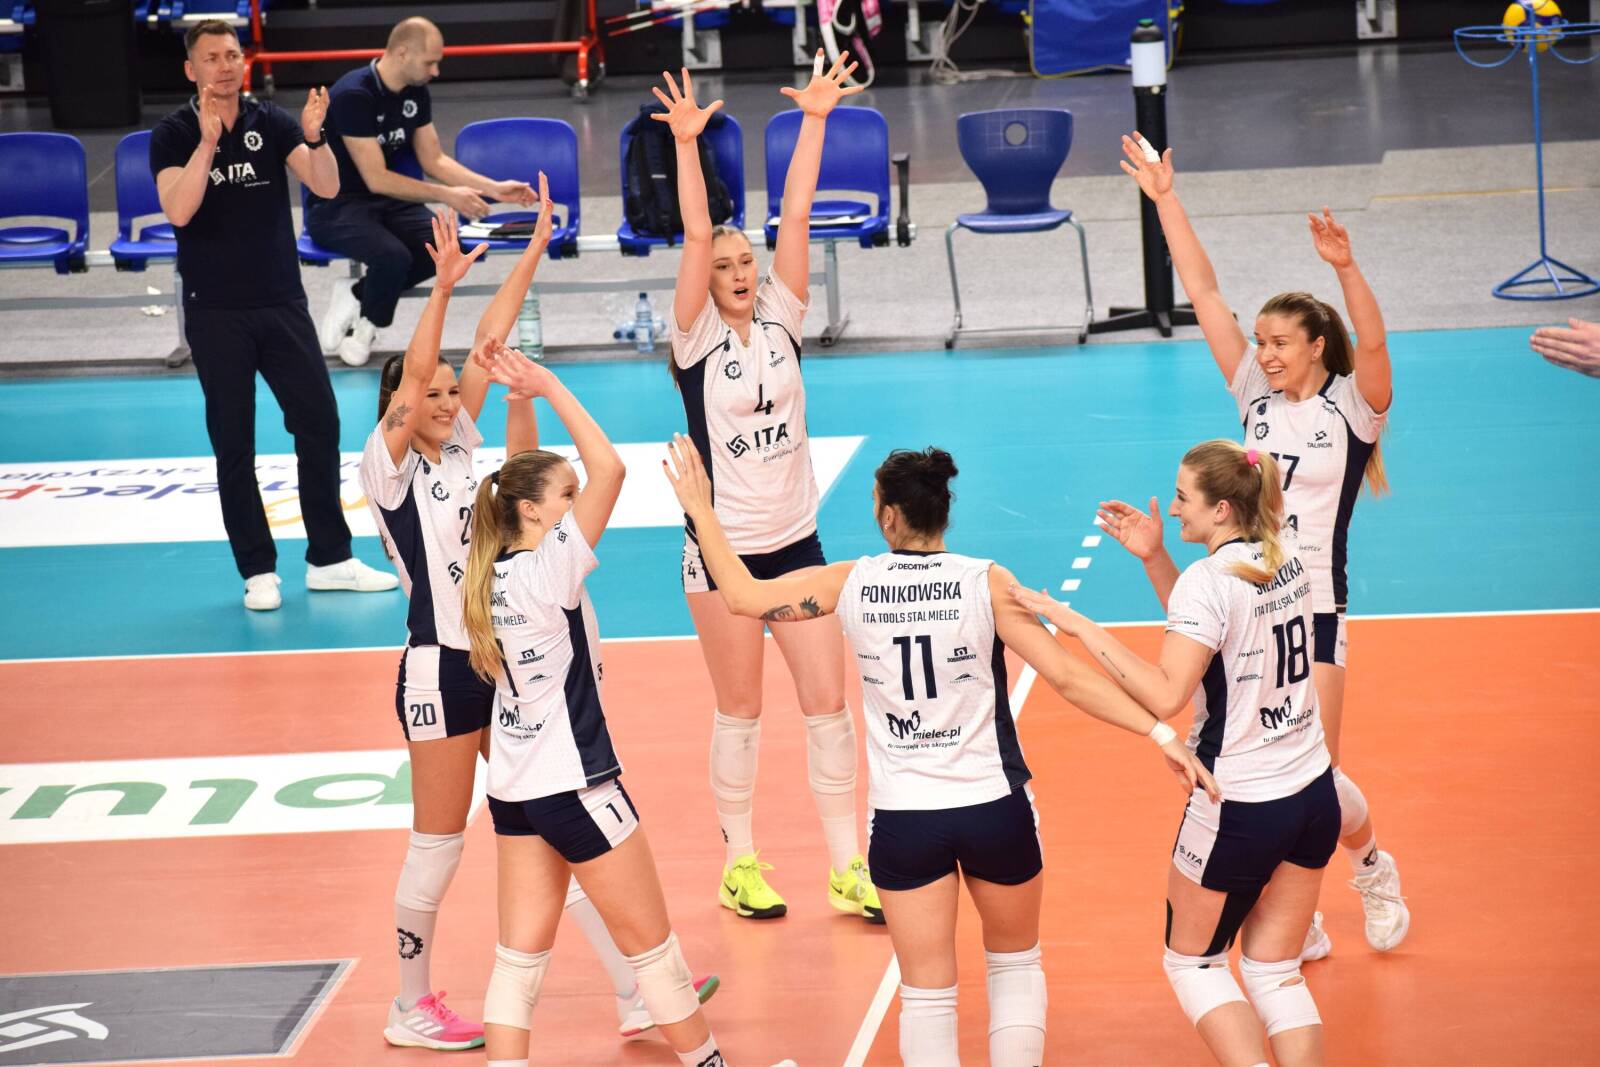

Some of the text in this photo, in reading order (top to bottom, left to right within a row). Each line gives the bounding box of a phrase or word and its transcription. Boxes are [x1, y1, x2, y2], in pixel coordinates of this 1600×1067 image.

[228, 162, 256, 180] ITA
[754, 383, 774, 415] 4
[754, 422, 788, 448] ITA
[756, 438, 791, 454] TOOLS
[459, 504, 476, 546] 2
[687, 560, 697, 579] 4
[861, 581, 962, 603] PONIKOWSKA
[863, 609, 960, 624] ITA TOOLS STAL MIELEC
[1272, 614, 1310, 688] 18
[892, 634, 938, 701] 11
[409, 702, 437, 727] 20
[912, 726, 961, 741] mielec.pl
[0, 760, 414, 825] plu
[605, 802, 623, 824] 1
[1187, 851, 1203, 867] ITA
